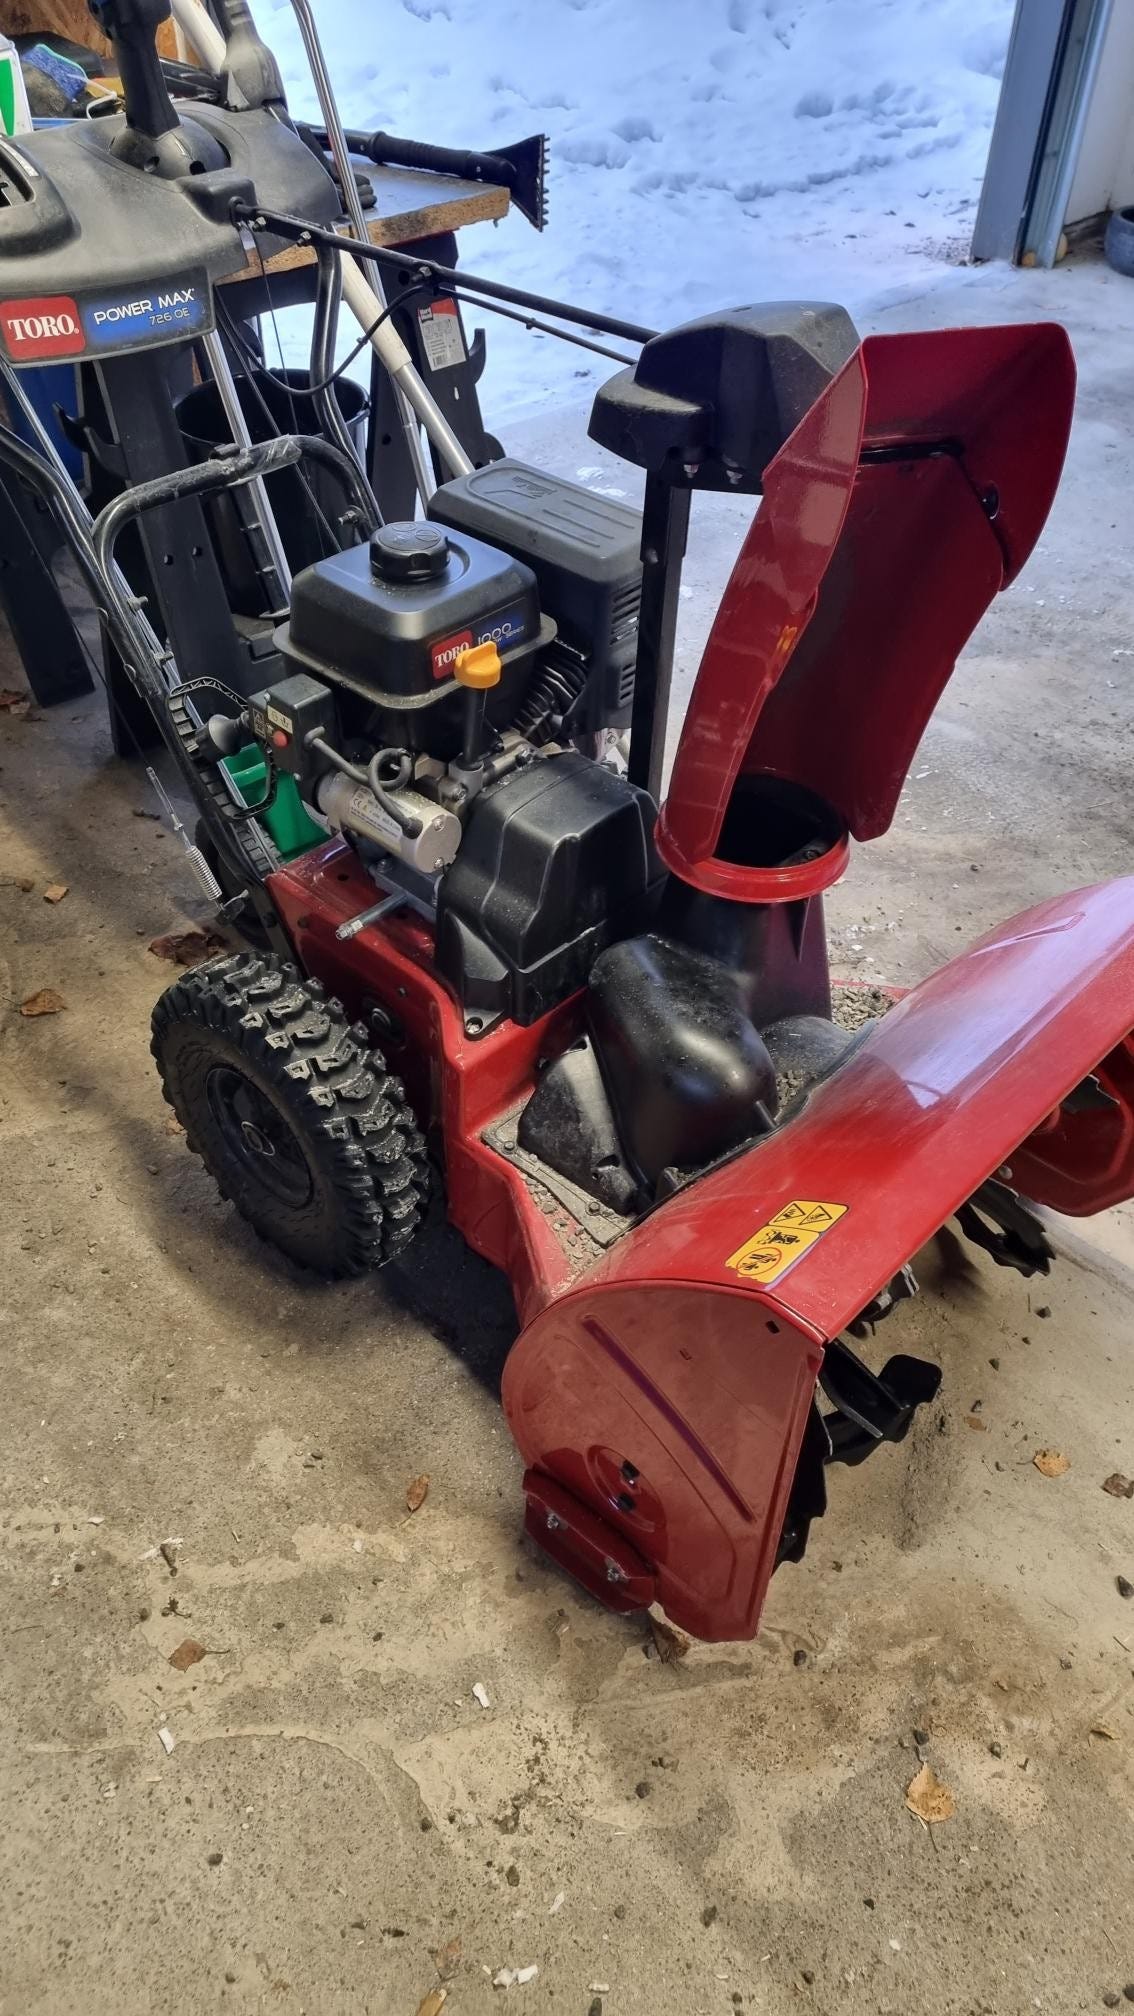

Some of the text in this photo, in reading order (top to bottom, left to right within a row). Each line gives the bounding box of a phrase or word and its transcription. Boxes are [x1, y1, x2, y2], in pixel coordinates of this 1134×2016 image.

[93, 289, 194, 326] POWER MAX
[149, 307, 190, 326] 726 OE
